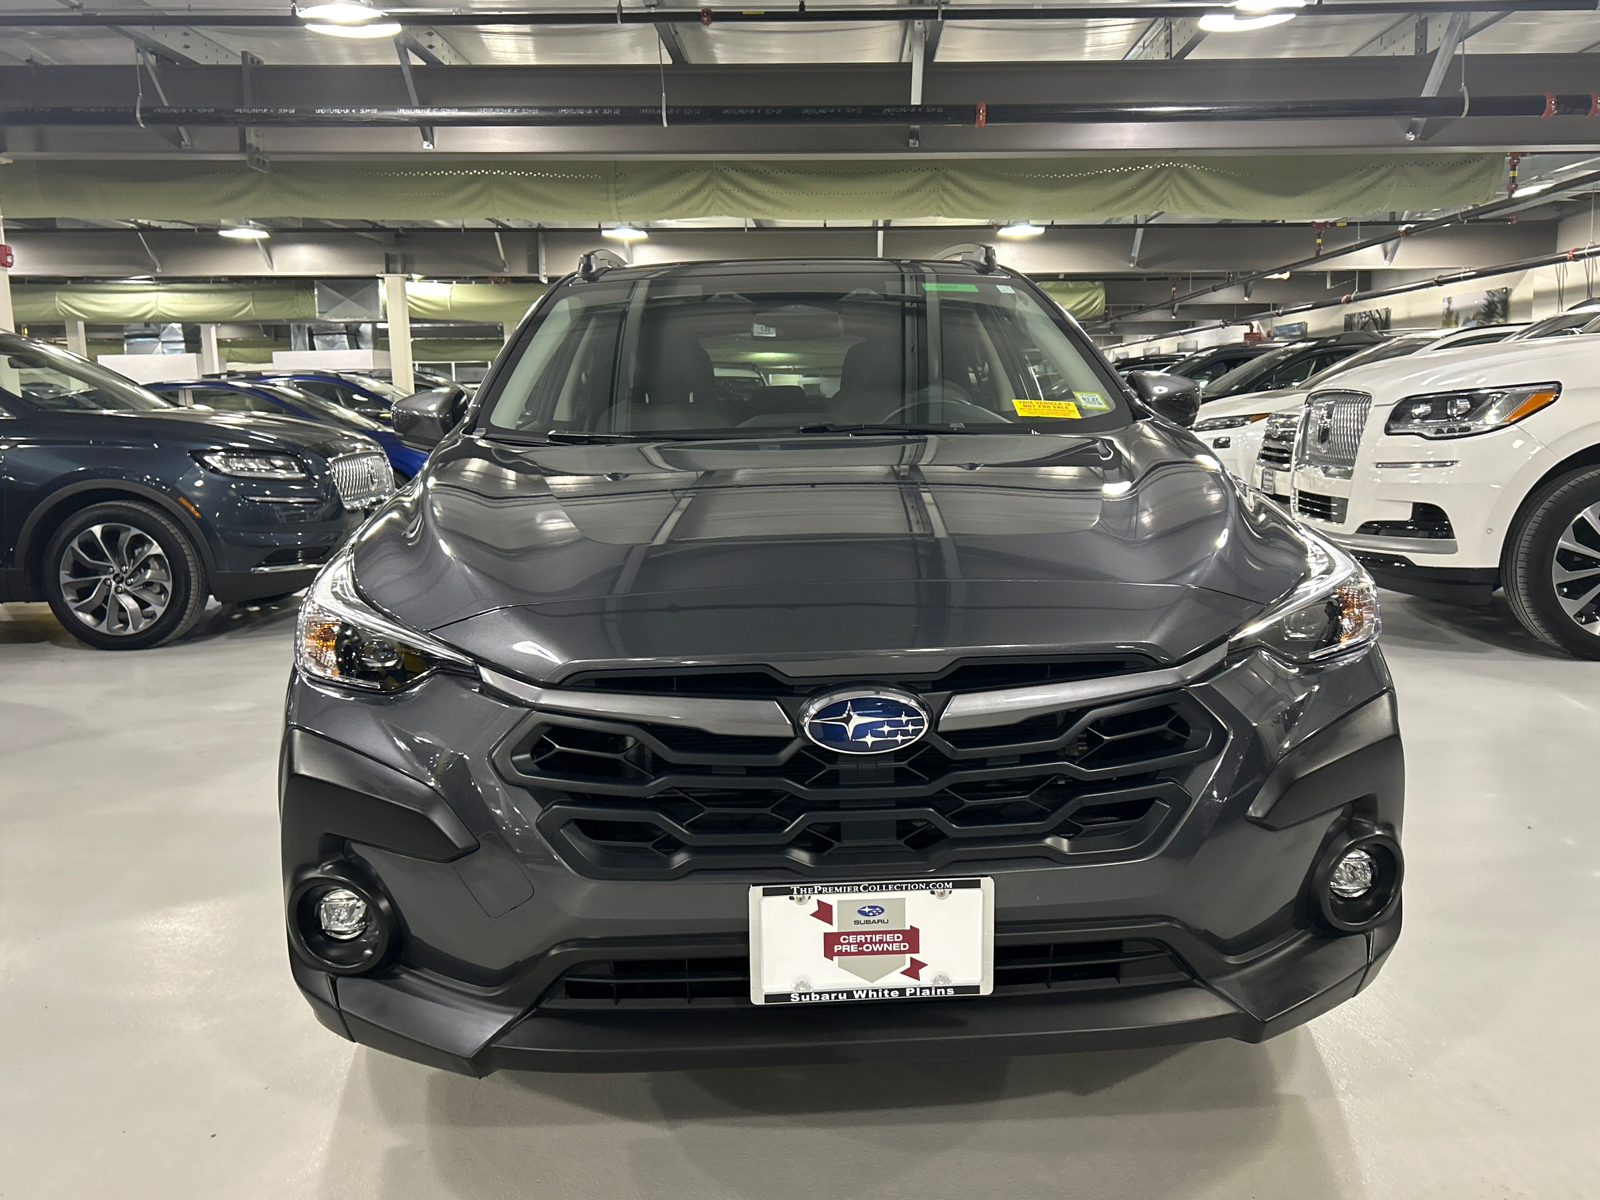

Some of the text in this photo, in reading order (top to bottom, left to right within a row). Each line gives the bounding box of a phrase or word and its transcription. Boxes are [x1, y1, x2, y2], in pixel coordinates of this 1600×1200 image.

[853, 918, 889, 926] SUBARU
[840, 933, 903, 943] CERTIFIED
[834, 942, 910, 953] PRE-OWNED
[790, 986, 955, 1002] Subaru White Plains
